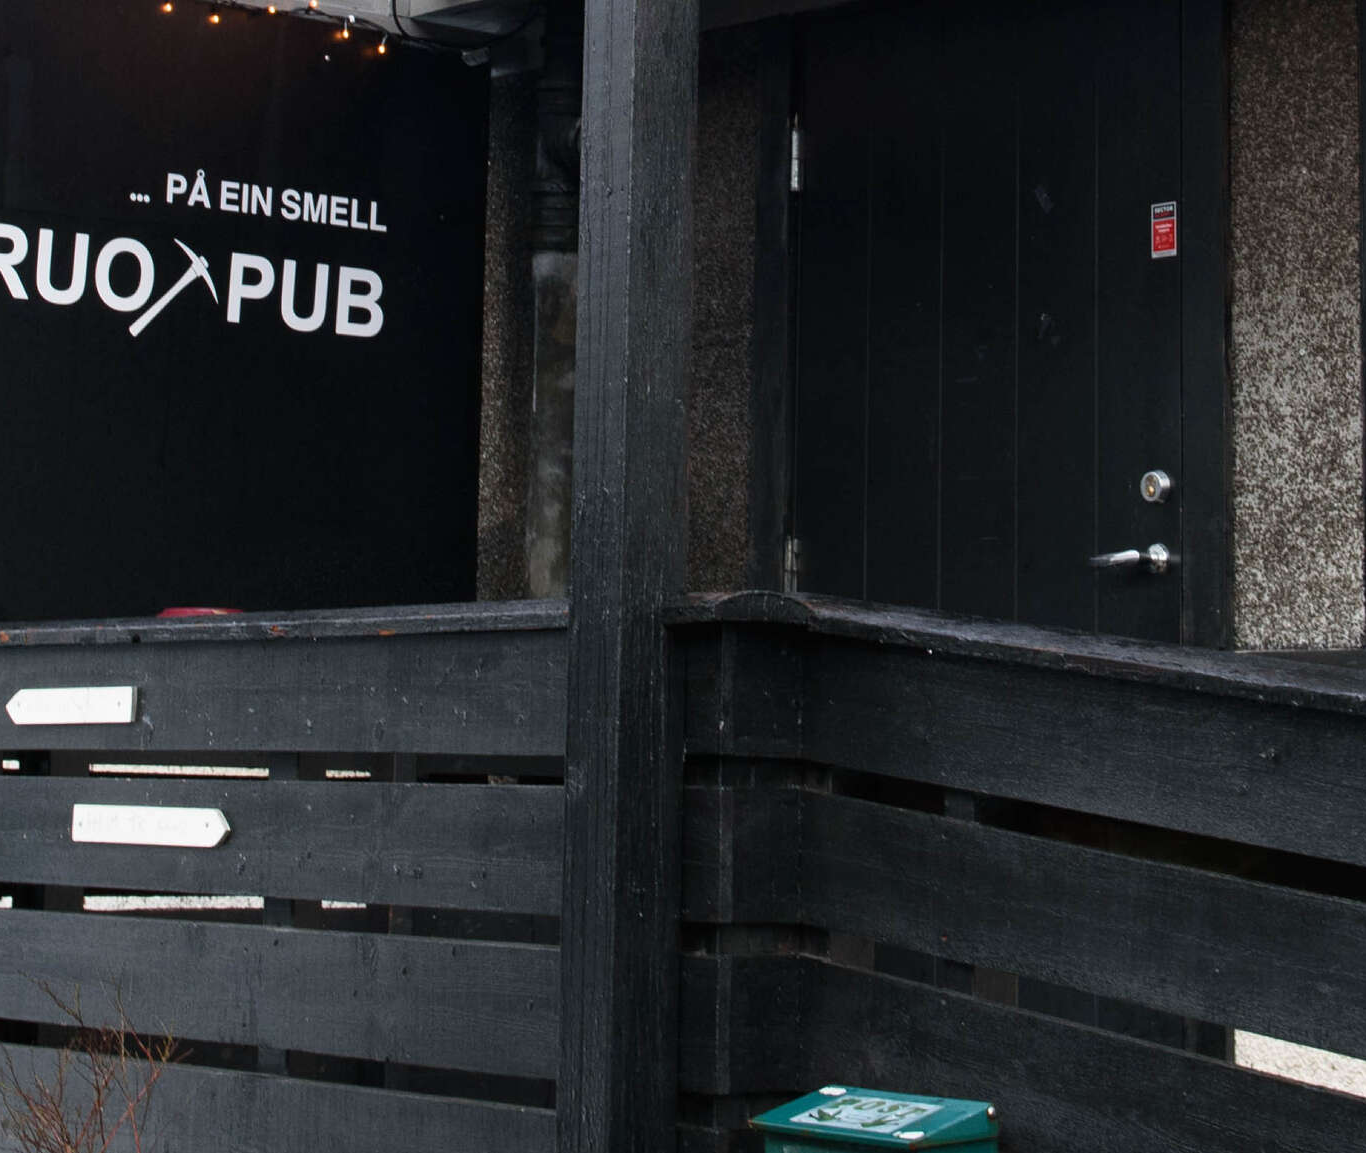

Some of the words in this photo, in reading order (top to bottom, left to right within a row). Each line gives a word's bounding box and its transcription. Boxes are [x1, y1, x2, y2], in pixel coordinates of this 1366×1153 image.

[166, 169, 211, 209] PÅ
[219, 180, 273, 217] EIN
[280, 188, 387, 232] SMELL
[226, 251, 384, 338] PUB
